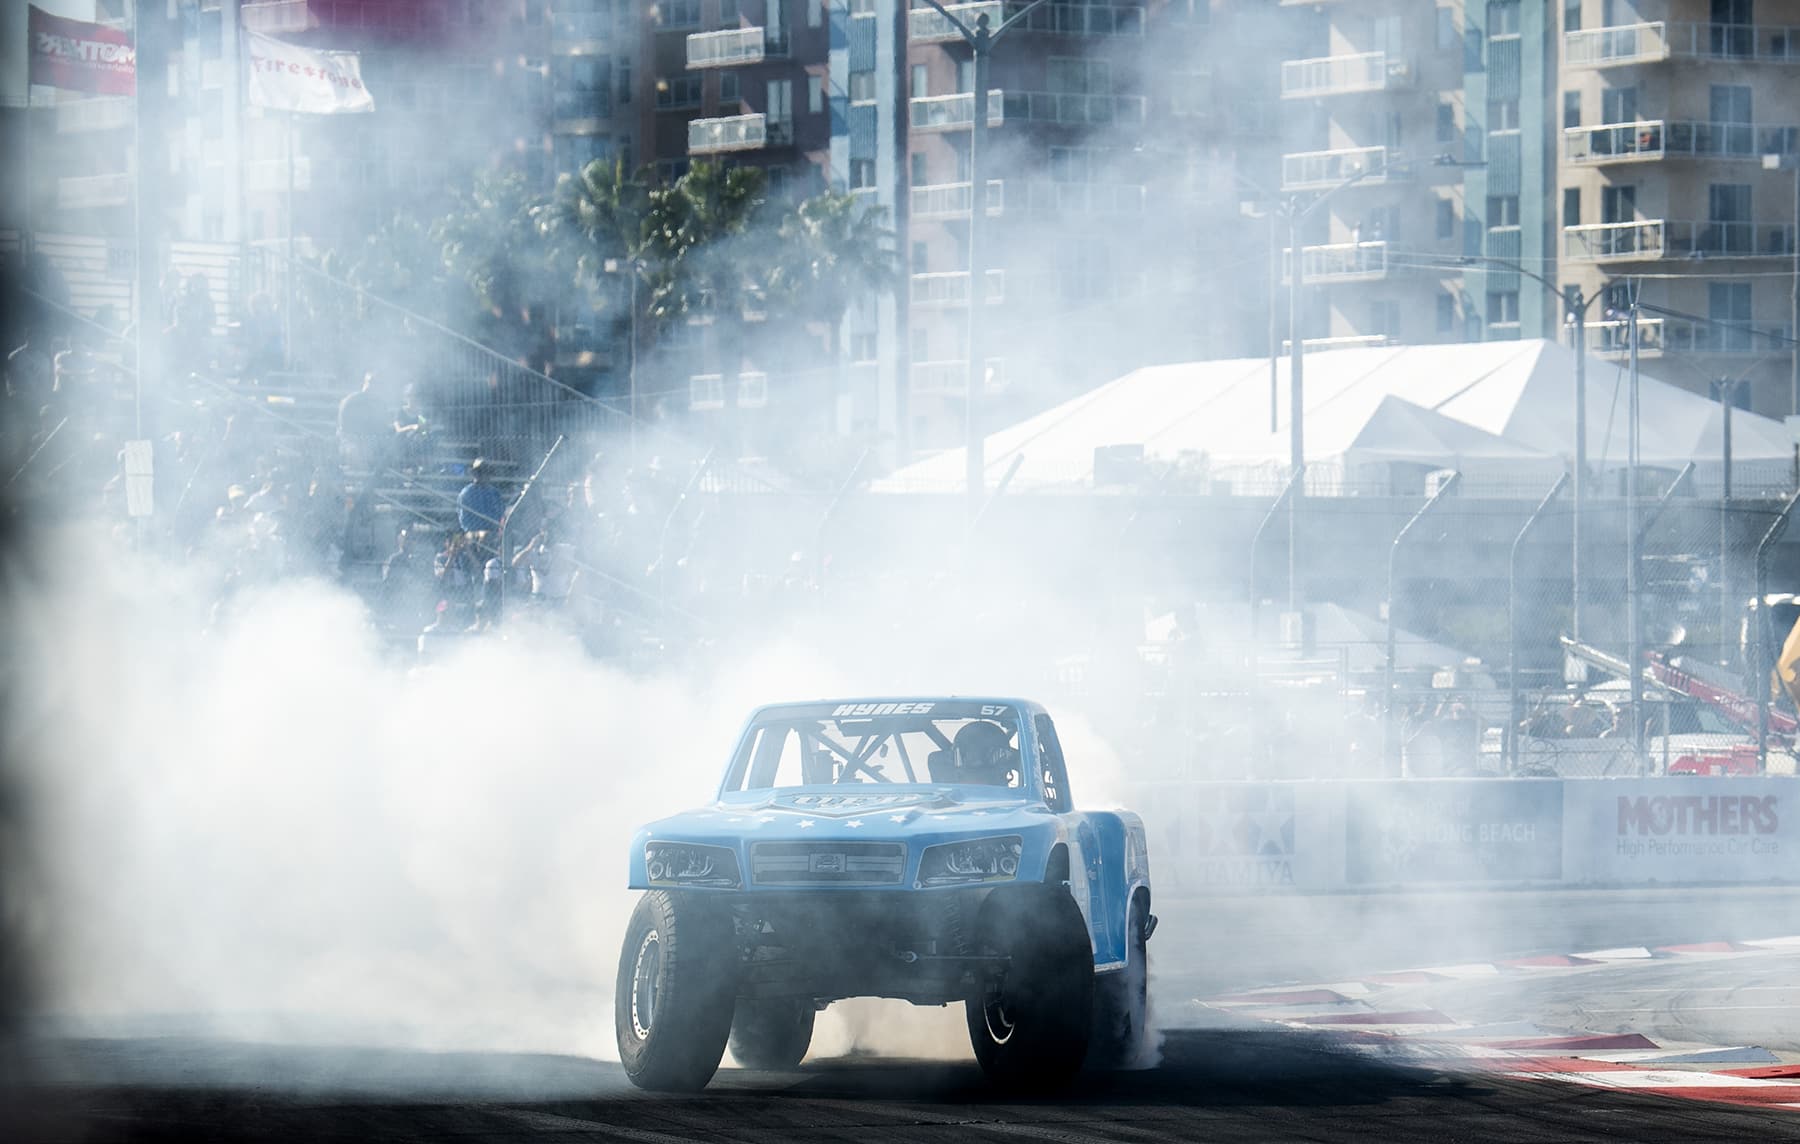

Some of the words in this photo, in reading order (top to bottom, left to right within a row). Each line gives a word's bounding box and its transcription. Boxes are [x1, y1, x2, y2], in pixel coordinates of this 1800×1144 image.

[250, 55, 361, 89] Firestone
[832, 703, 935, 717] HYNES
[1617, 795, 1778, 836] MOTHERS
[1480, 823, 1535, 842] BEACH
[1616, 838, 1644, 857] High
[1649, 838, 1724, 855] Performance
[1752, 838, 1778, 855] Care
[1199, 860, 1296, 886] TAMIYA
